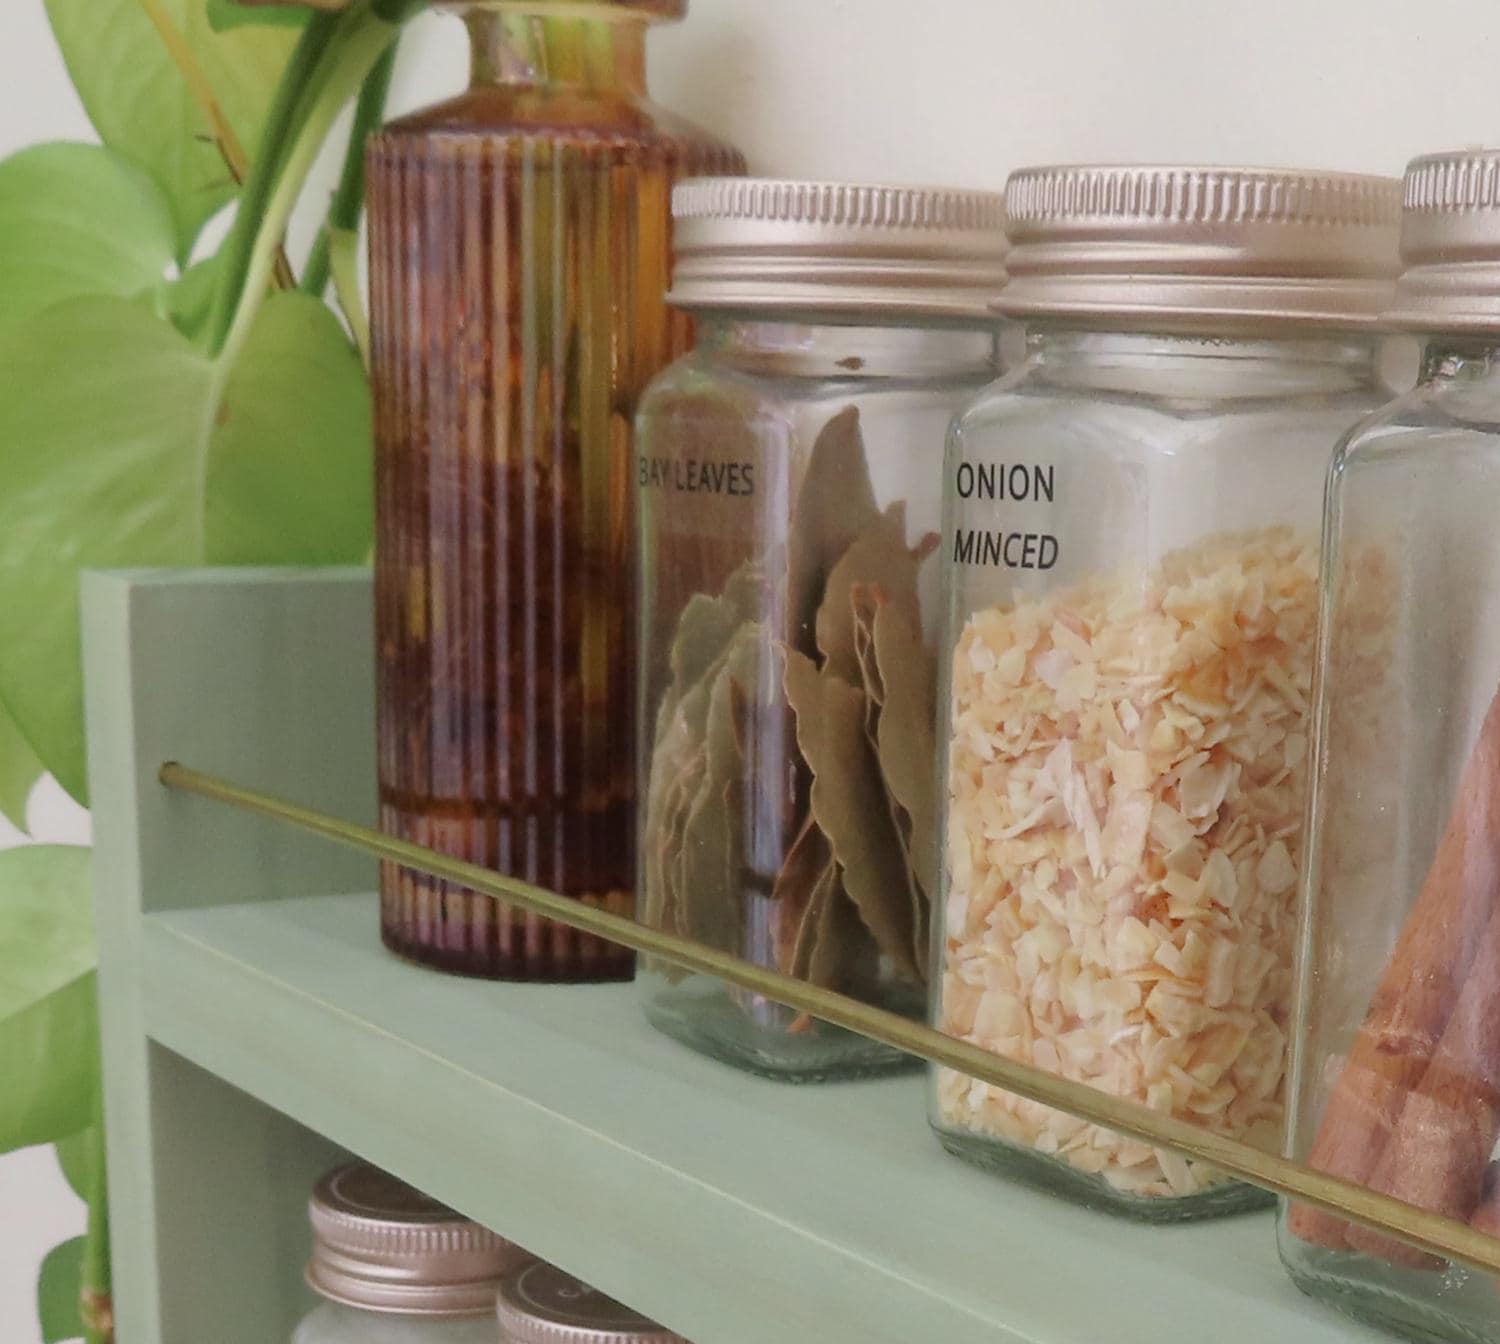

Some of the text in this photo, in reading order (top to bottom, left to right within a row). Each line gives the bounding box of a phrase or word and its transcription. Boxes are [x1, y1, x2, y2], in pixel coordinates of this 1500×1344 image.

[639, 457, 755, 496] BAY LEAVES
[957, 462, 1055, 502] ONION
[953, 529, 1060, 570] MINCED
